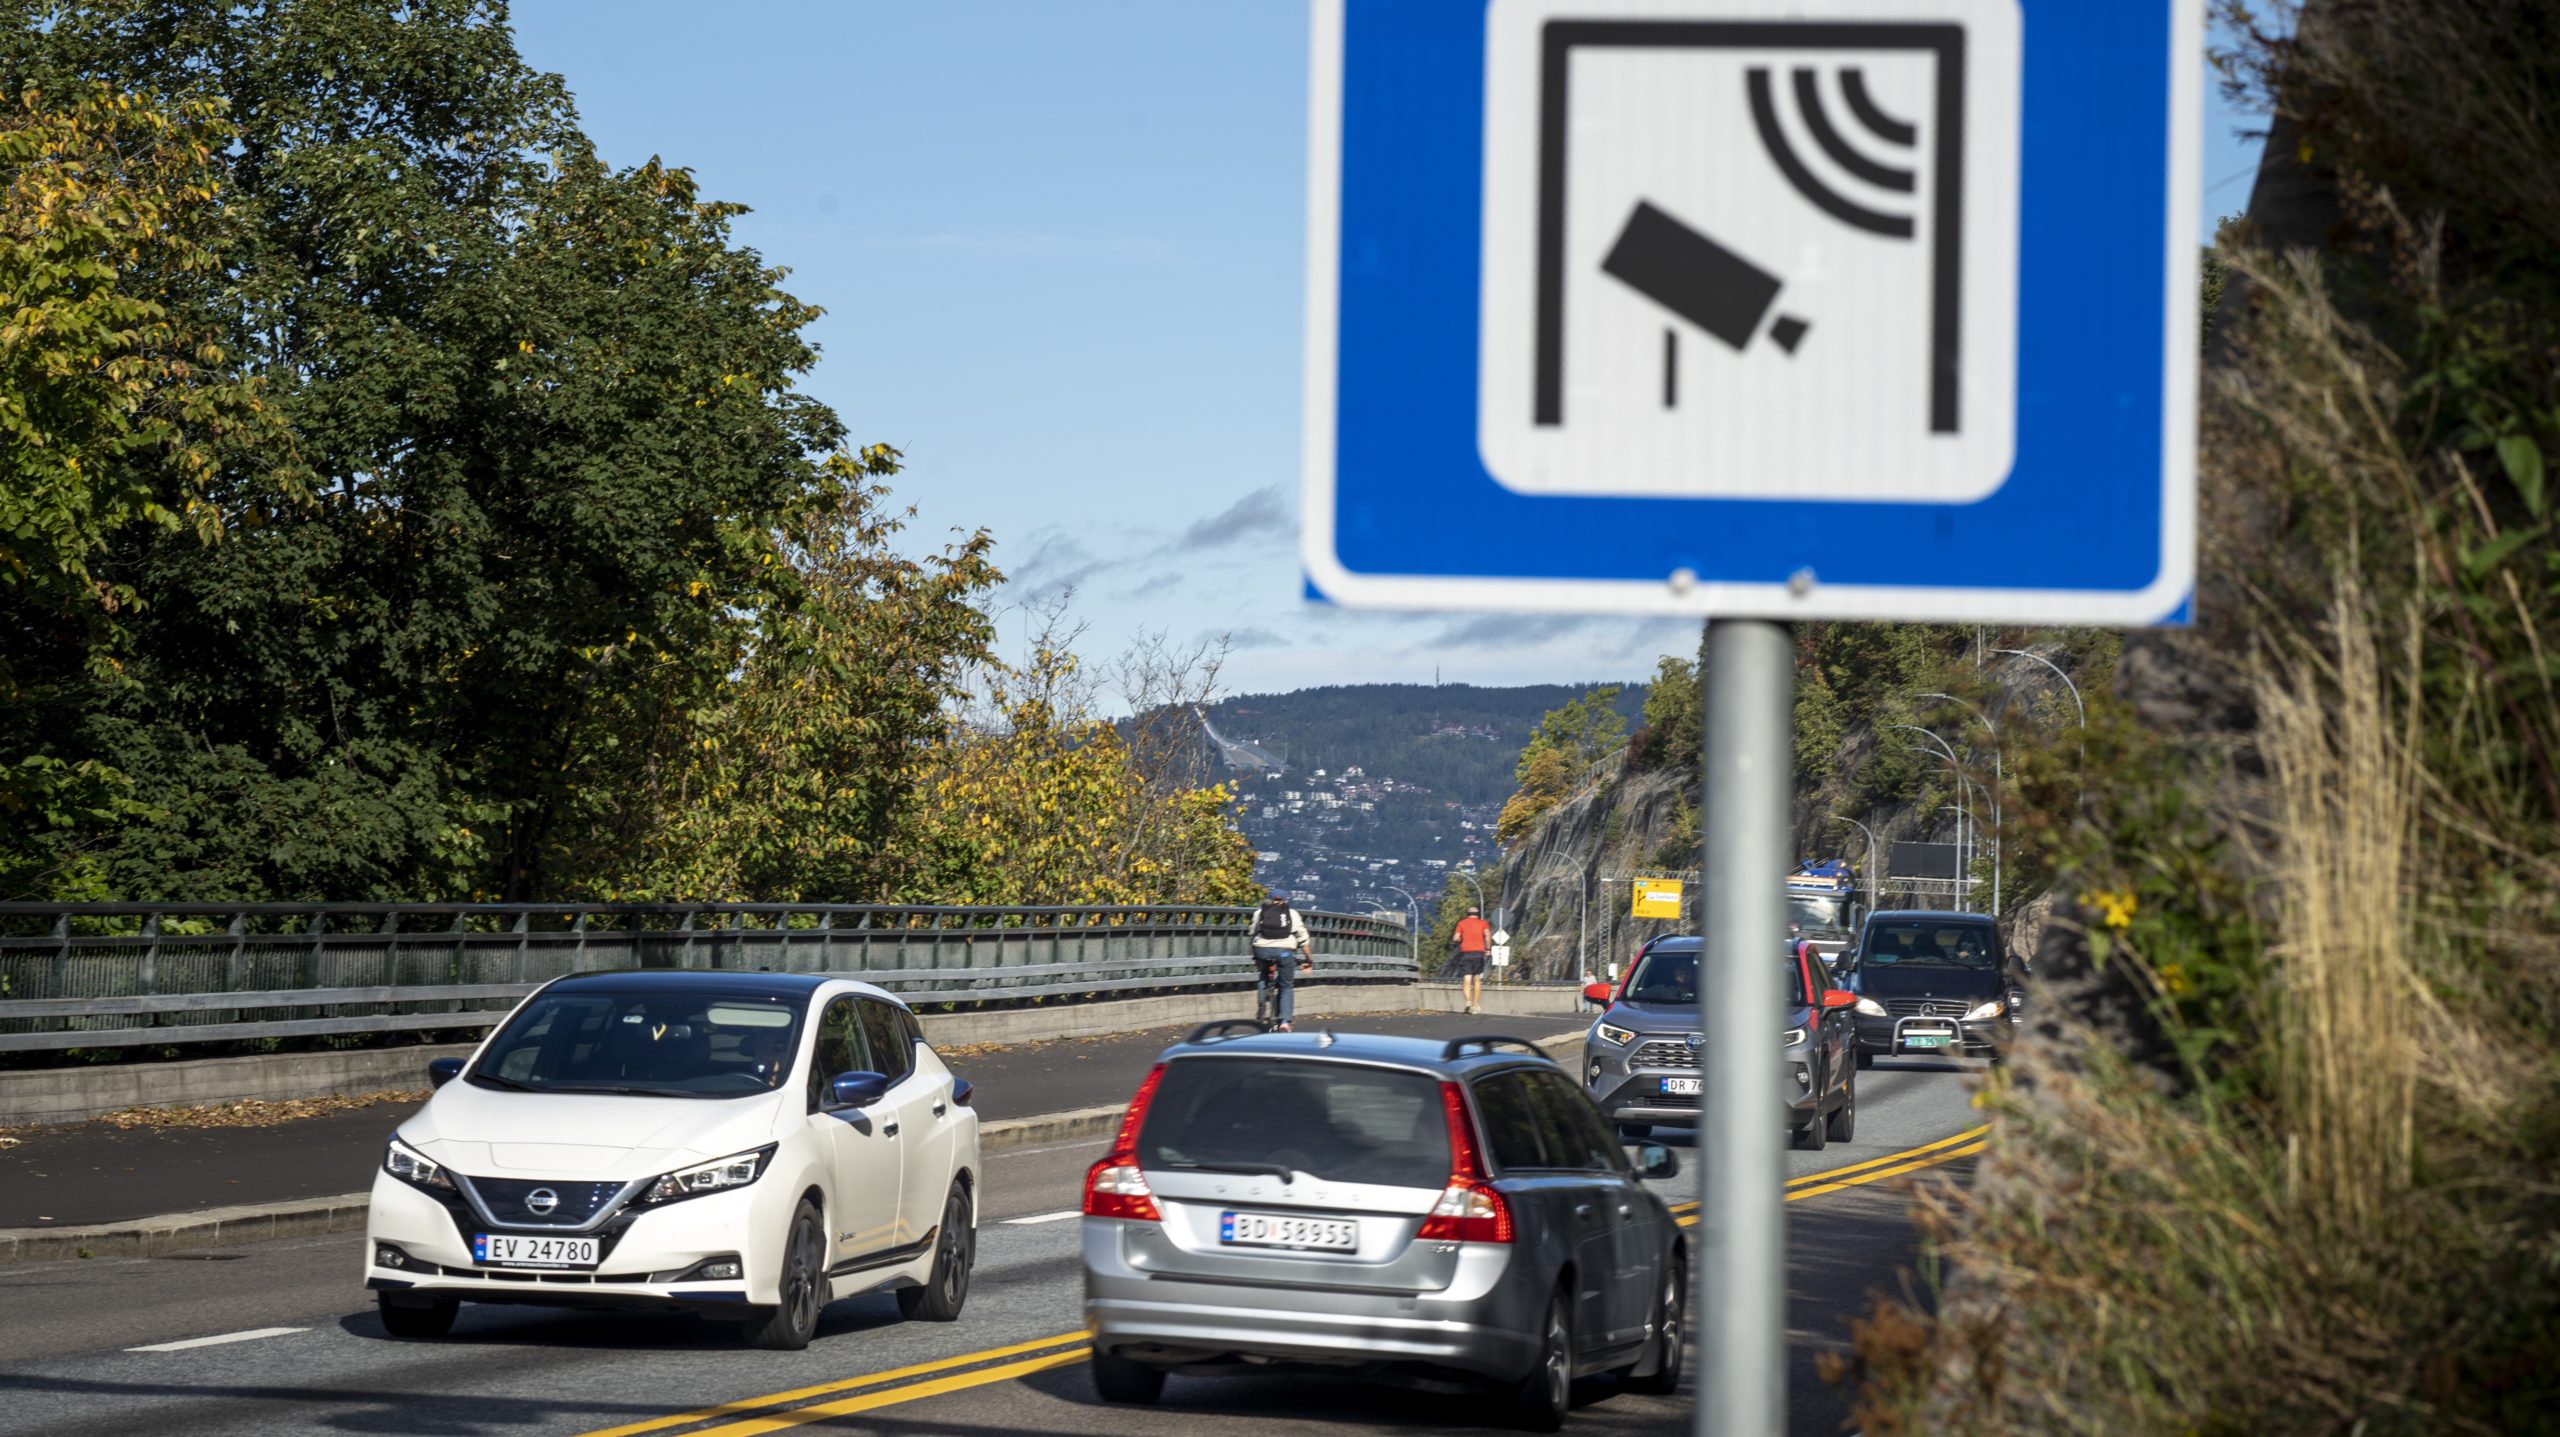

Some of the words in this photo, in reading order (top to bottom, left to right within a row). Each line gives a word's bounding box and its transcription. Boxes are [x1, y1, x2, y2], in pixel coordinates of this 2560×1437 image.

[1670, 1080, 1686, 1091] DR
[1239, 1218, 1268, 1239] BD
[1281, 1220, 1353, 1246] 58955
[494, 1239, 518, 1258] EV
[528, 1240, 592, 1261] 24780
